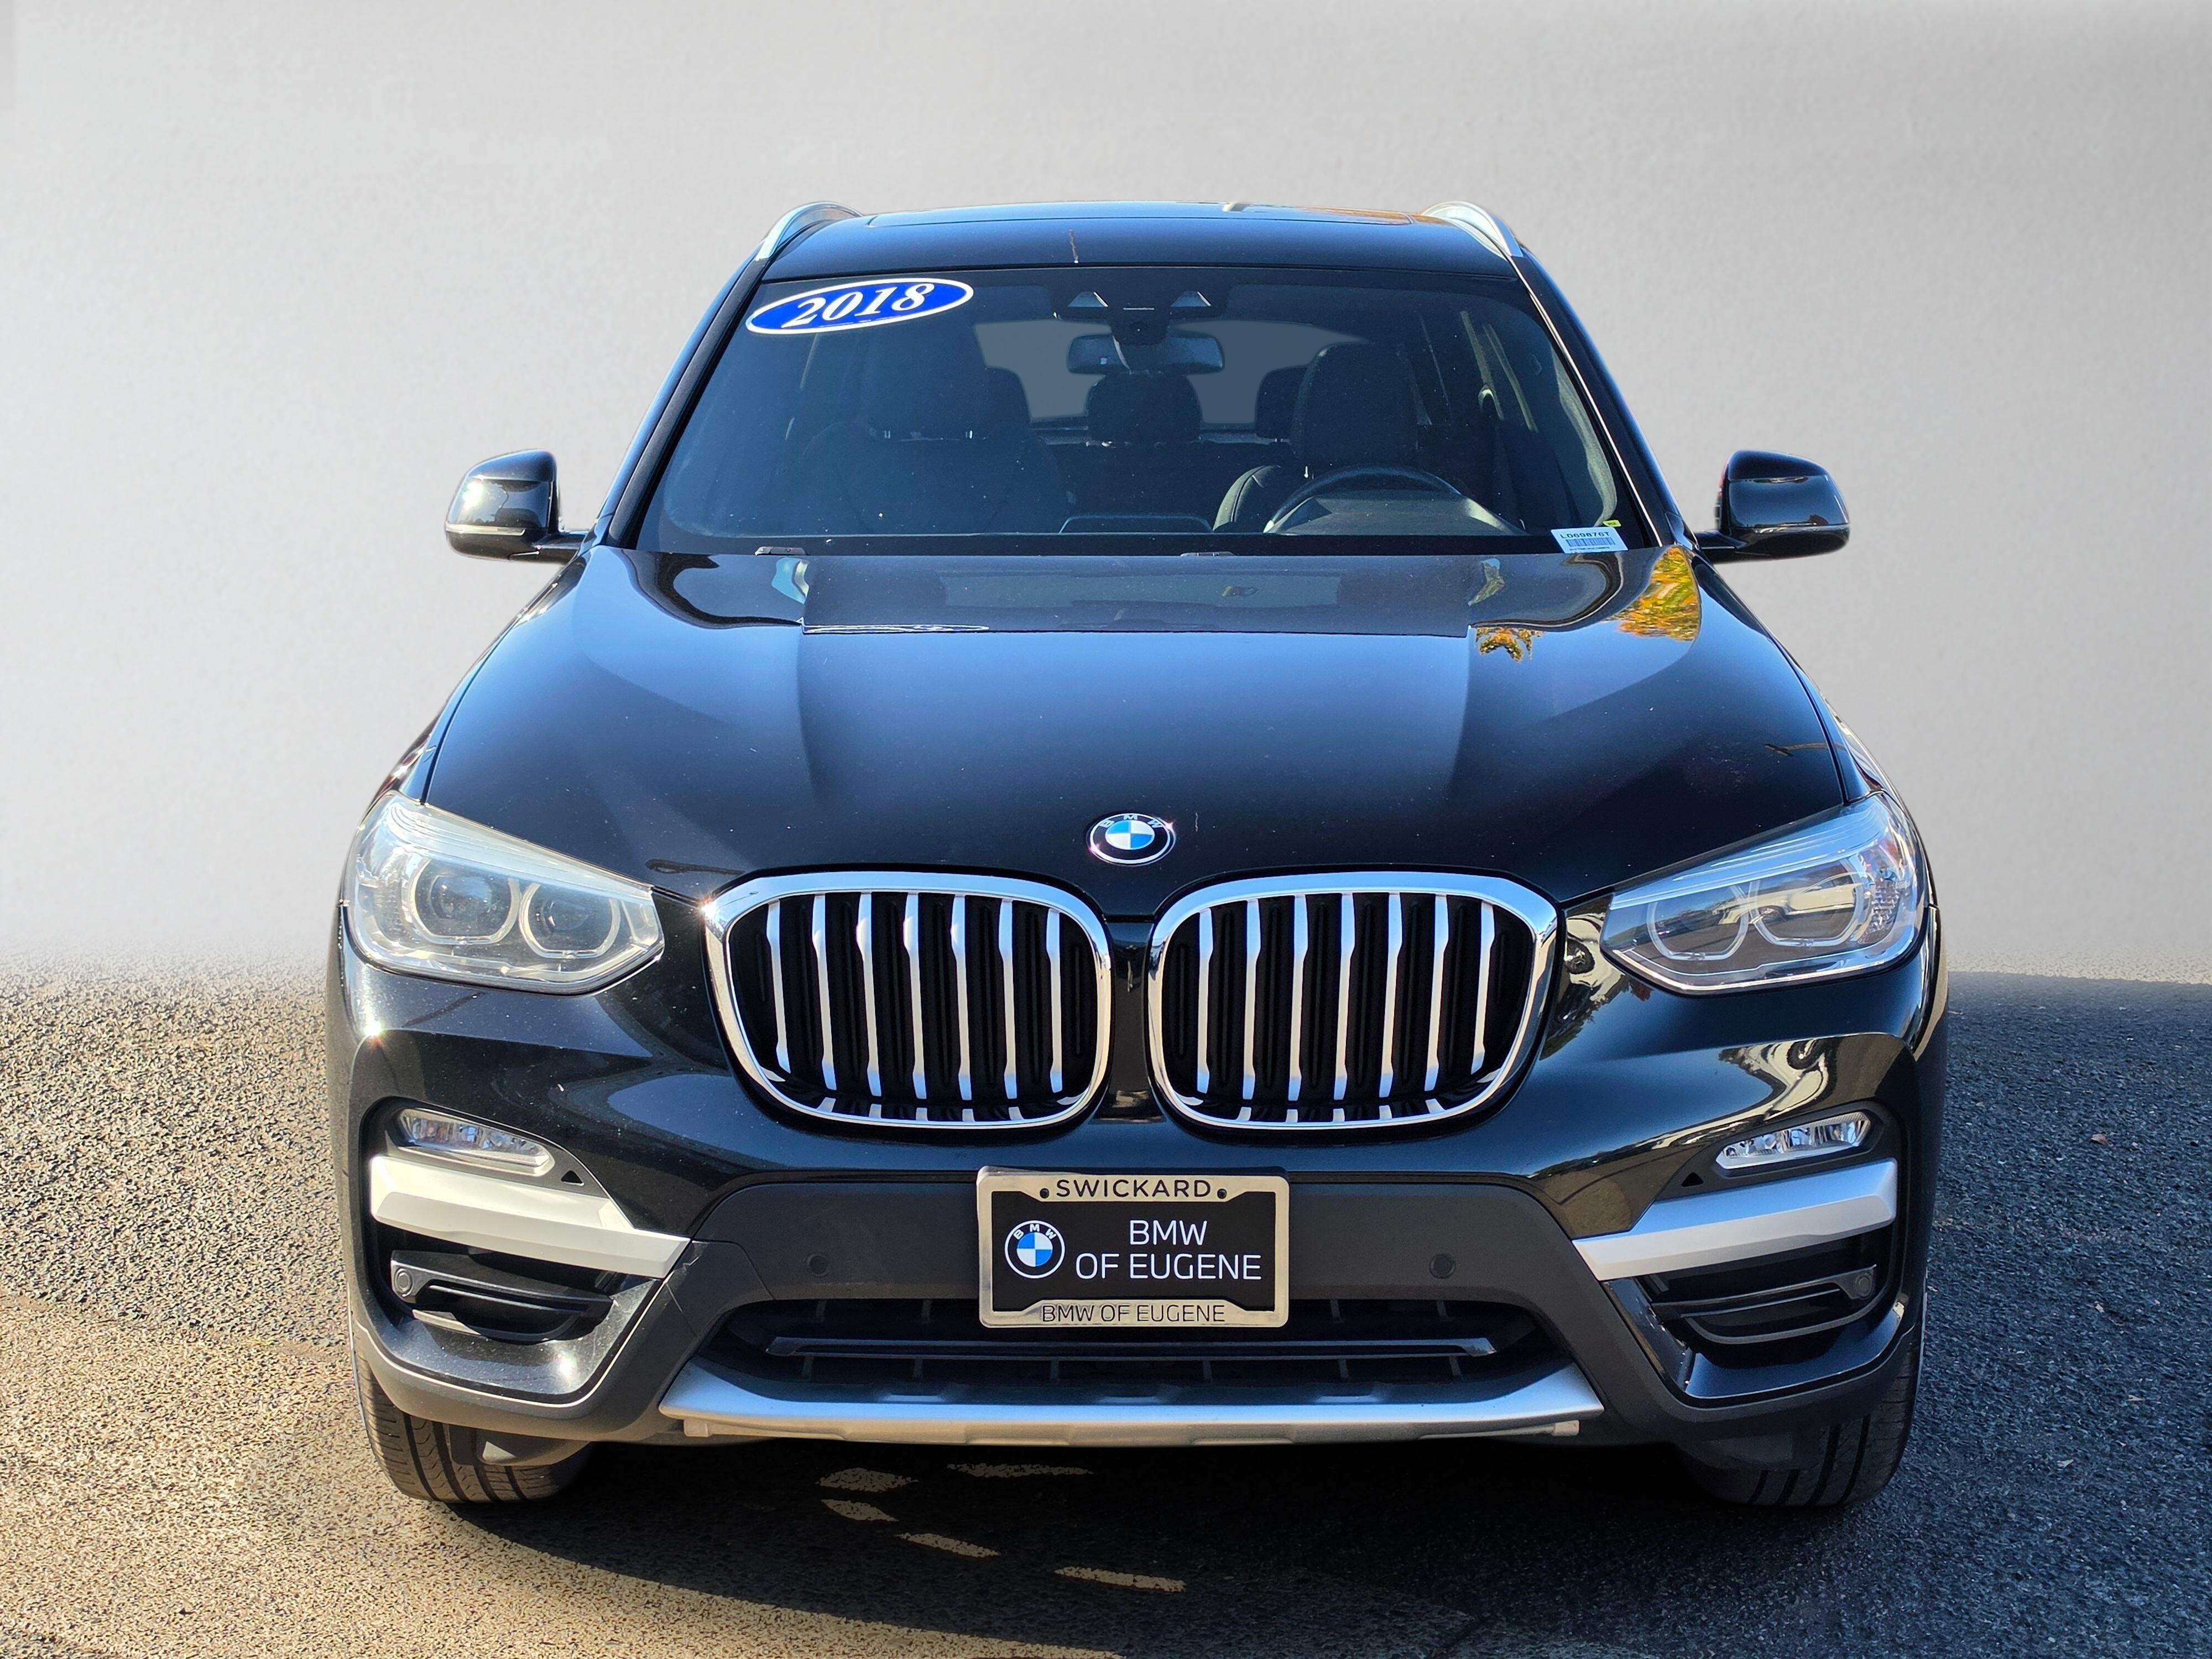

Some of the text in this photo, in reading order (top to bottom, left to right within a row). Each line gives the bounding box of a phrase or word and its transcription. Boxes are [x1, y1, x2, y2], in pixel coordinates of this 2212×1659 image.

[781, 283, 935, 328] 2018
[1098, 815, 1164, 828] BMW
[1056, 1179, 1212, 1198] SWICKARD
[1013, 1224, 1057, 1240] BMW
[1129, 1219, 1208, 1245] BMW
[1075, 1253, 1262, 1280] OF EUGENE
[1041, 1304, 1226, 1322] BMW OF EUGENE
